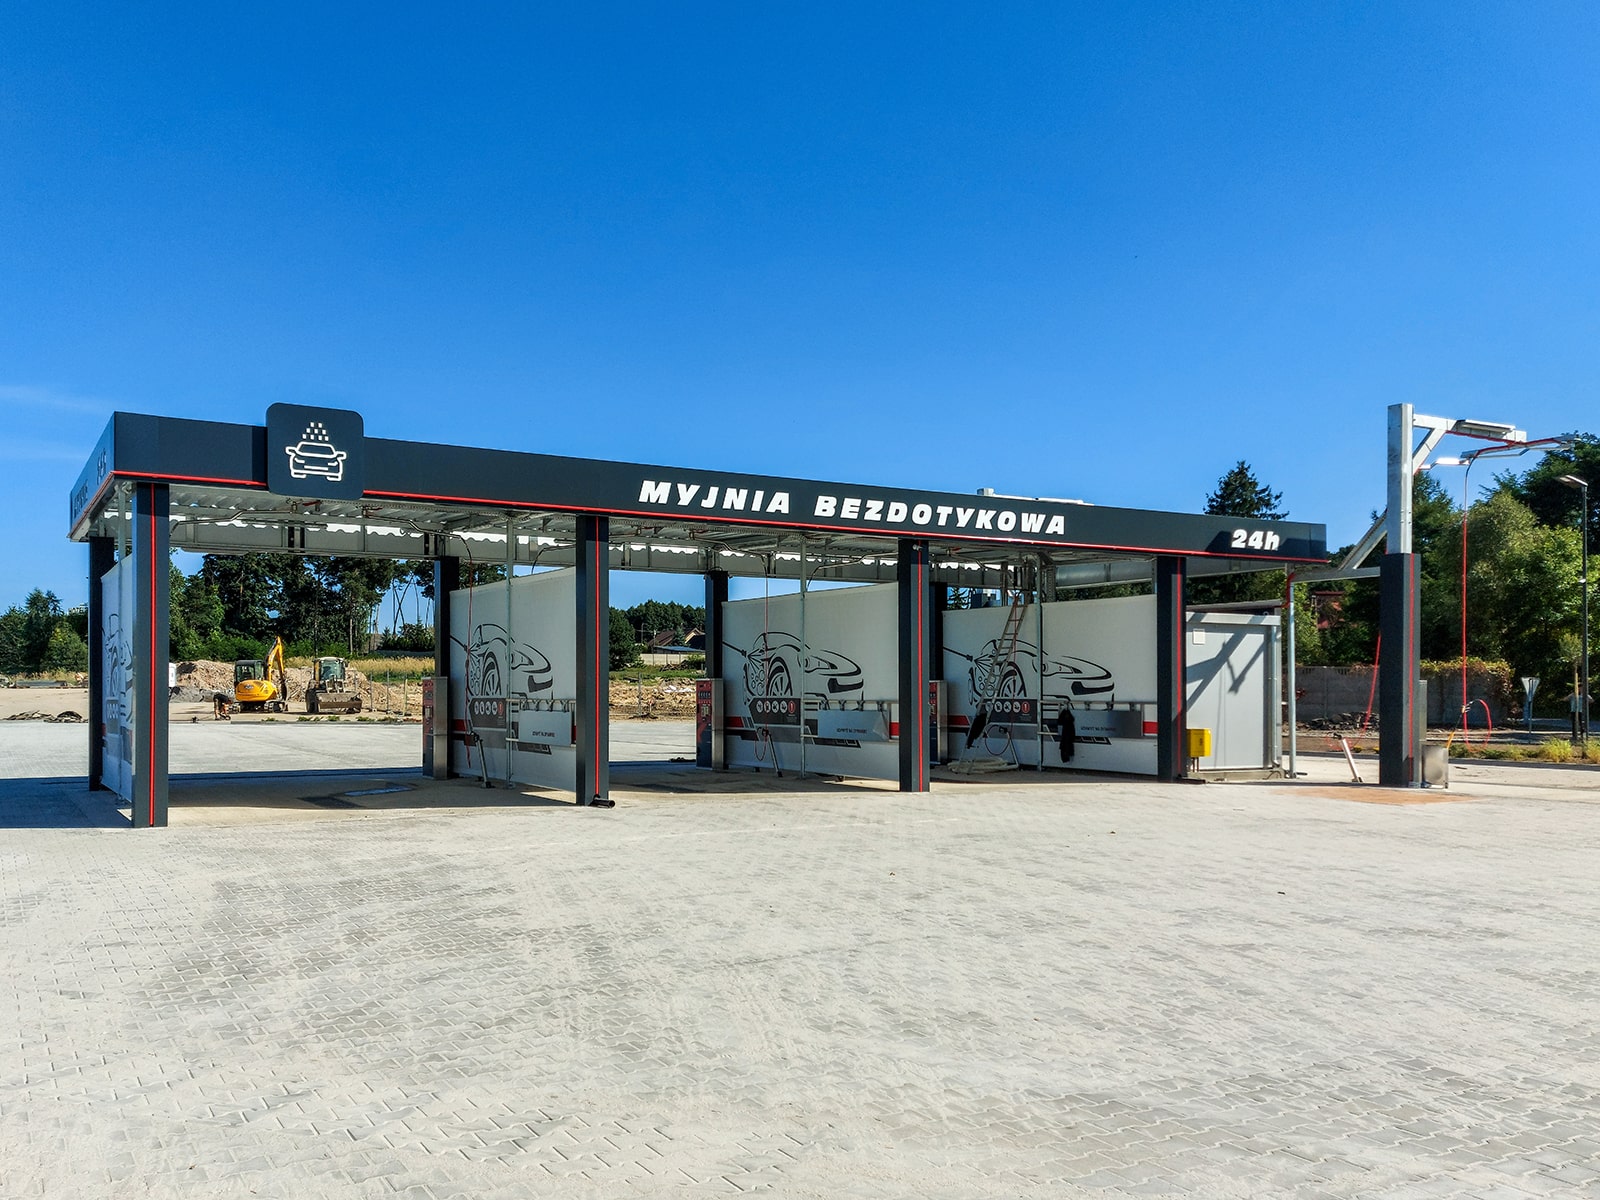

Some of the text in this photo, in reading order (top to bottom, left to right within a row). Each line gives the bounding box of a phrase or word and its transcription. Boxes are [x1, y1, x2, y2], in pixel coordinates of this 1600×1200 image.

[638, 480, 1065, 535] MYJNIA BEZDOTYKOWA
[1231, 529, 1280, 551] 24h
